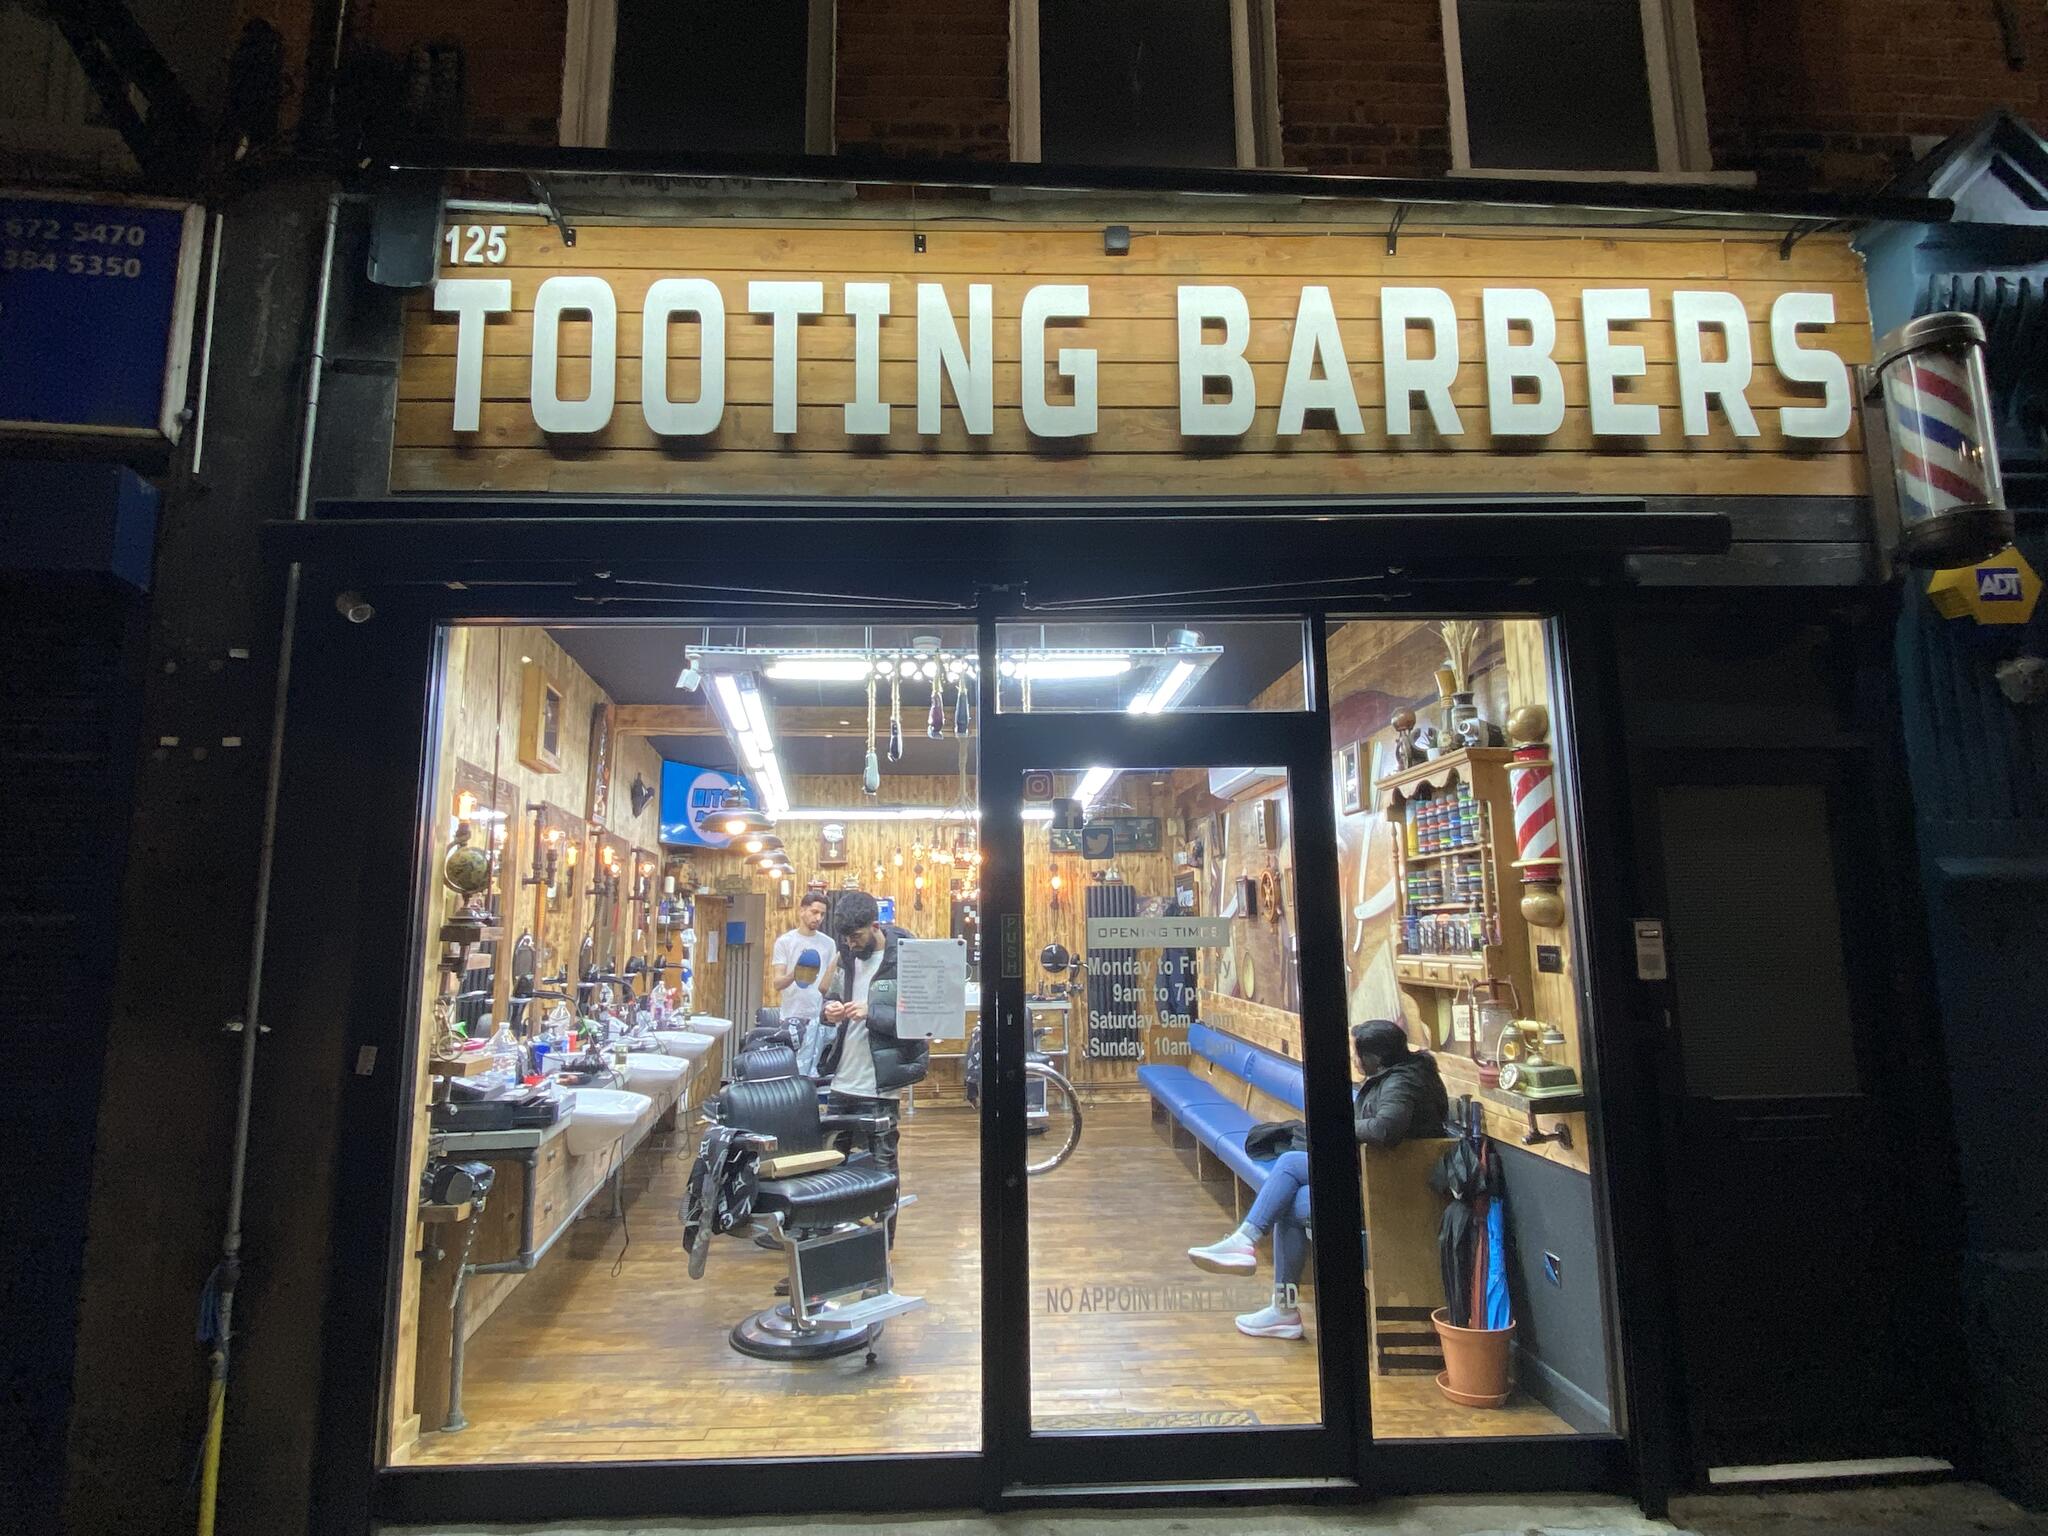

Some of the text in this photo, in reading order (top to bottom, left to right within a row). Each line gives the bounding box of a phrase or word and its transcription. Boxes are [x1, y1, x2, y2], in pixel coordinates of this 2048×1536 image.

[73, 222, 146, 247] 5470
[445, 225, 508, 263] 125
[68, 254, 141, 278] 5350
[434, 275, 1852, 439] TOOTING BARBERS
[1981, 573, 2019, 596] ADT
[1098, 927, 1168, 938] OPENING
[1007, 917, 1017, 974] PUSH
[1088, 957, 1151, 979] Monday
[1158, 959, 1174, 975] to
[1113, 983, 1146, 1002] 9am
[1153, 984, 1169, 1001] to
[1090, 1010, 1153, 1033] Saturday
[1160, 1010, 1191, 1028] 9am
[1090, 1037, 1145, 1061] Sunday
[1154, 1037, 1192, 1056] 10am
[1046, 1287, 1073, 1313] NO
[1079, 1285, 1211, 1312] APPOINTMENT
